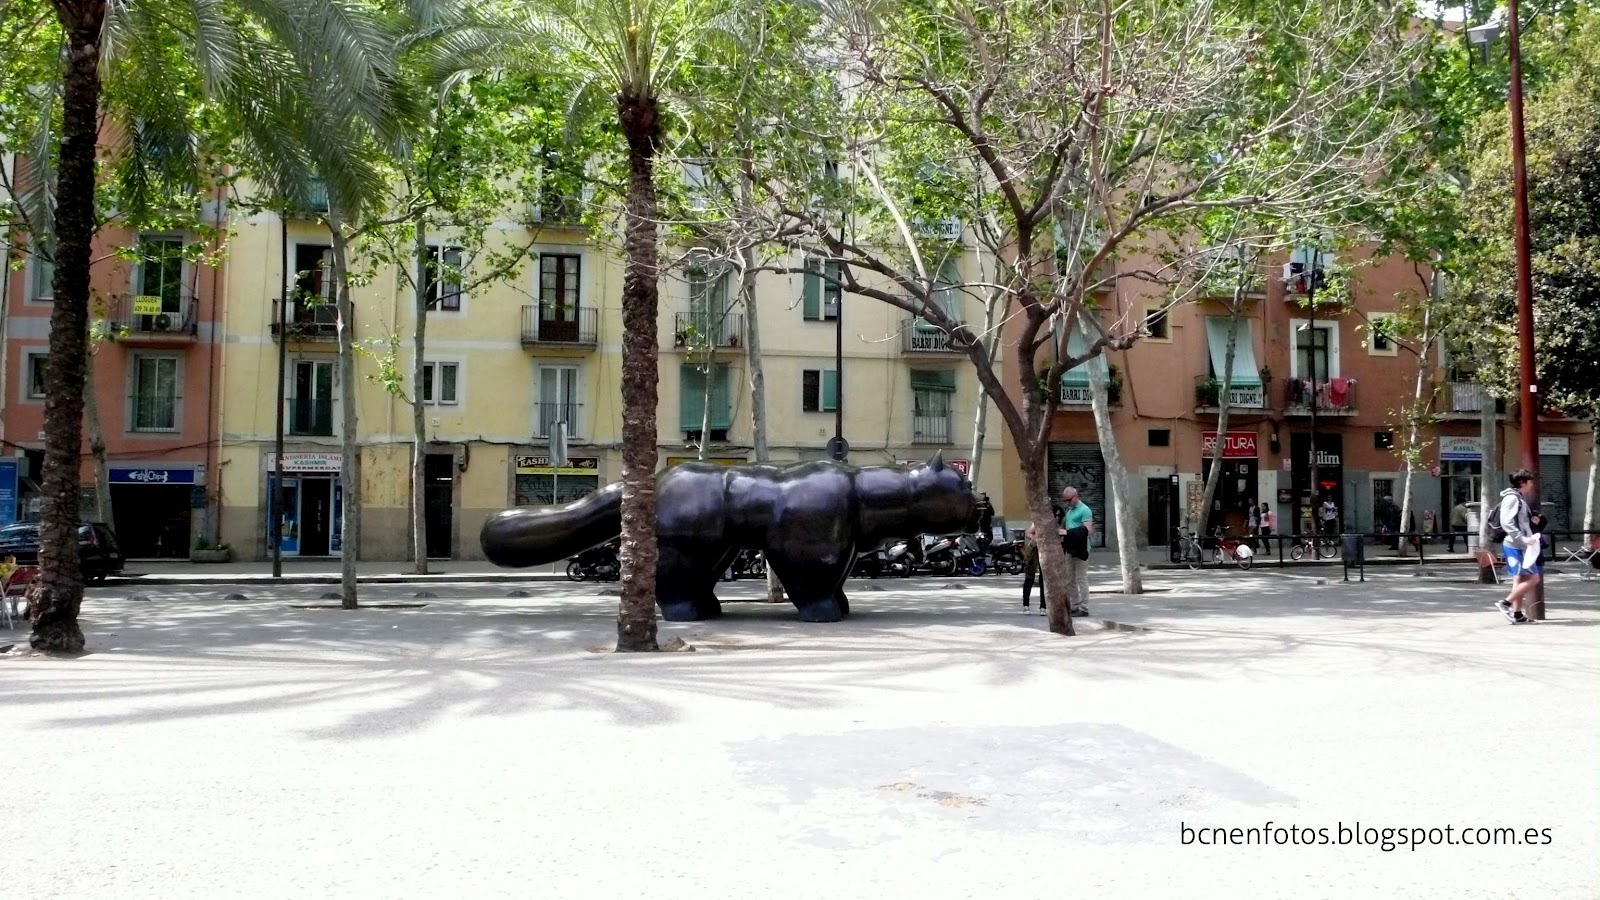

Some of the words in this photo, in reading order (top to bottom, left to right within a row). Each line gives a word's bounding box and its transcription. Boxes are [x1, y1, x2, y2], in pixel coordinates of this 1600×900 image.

[912, 337, 931, 349] BARRI
[1062, 389, 1081, 401] BARRI
[1442, 438, 1482, 450] SUPERMERCA
[271, 454, 316, 463] CNISSERIA
